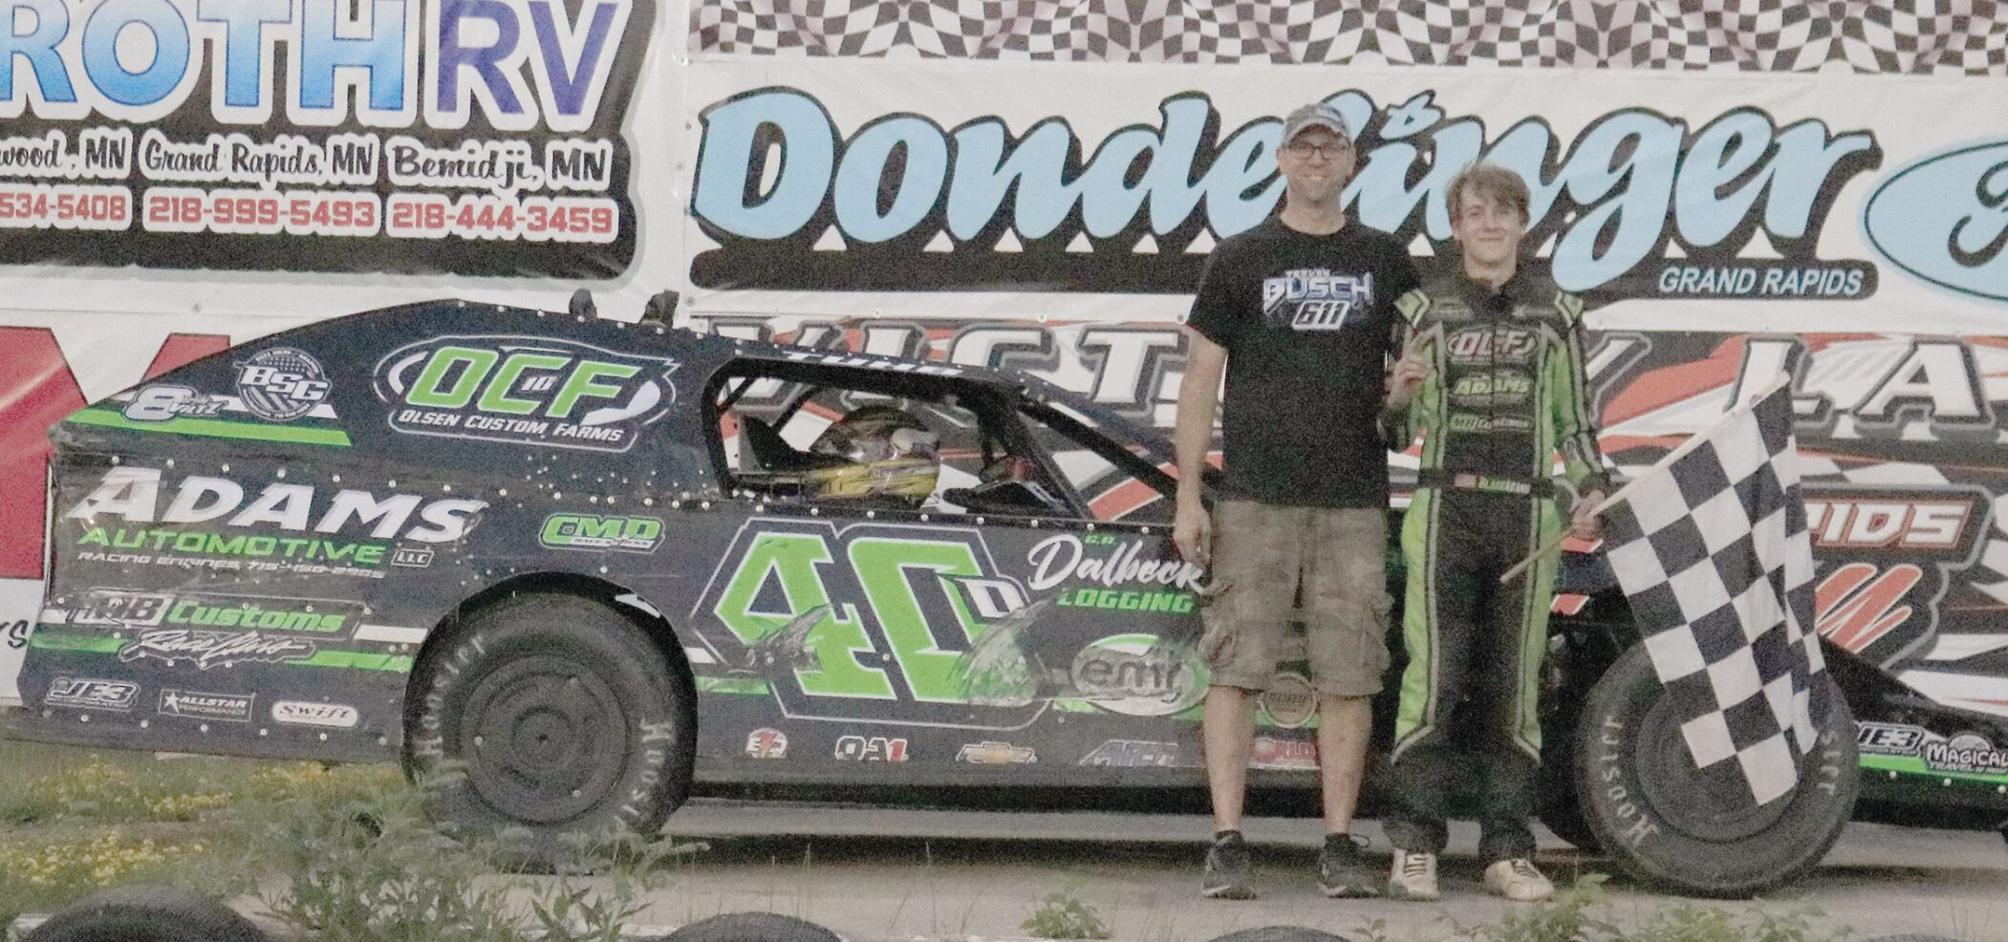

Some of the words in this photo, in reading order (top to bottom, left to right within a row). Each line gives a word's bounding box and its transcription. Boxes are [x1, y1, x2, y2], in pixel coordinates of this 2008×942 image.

[0, 0, 405, 110] ROTH
[437, 0, 619, 116] RV
[84, 136, 126, 169] MN
[145, 138, 222, 172] Grand
[231, 139, 323, 182] Rapids,
[332, 140, 373, 176] MN
[392, 144, 539, 190] Bemidji,
[551, 148, 607, 182] MN
[149, 195, 376, 227] 218-999-5493
[392, 201, 613, 234] 218-444-3459
[1262, 272, 1375, 317] BUSCH
[1659, 266, 1758, 295] GRAND
[1761, 268, 1863, 298] RAPIDS
[1292, 300, 1351, 330] 611
[239, 364, 329, 401] BSG
[405, 345, 643, 419] OCF
[398, 408, 461, 427] OLSEN
[464, 414, 549, 435] CUSTOM
[552, 422, 624, 443] FARMS
[64, 465, 490, 543] ADAMS
[76, 526, 386, 565] AUTOMOTIVE
[395, 551, 429, 565] LLC
[542, 516, 661, 545] CMD
[77, 551, 152, 564] RACING
[1027, 533, 1204, 595] Dalbeck
[168, 599, 348, 633] Customs
[1056, 587, 1195, 614] LOGGING
[180, 695, 248, 708] ALLSTAR
